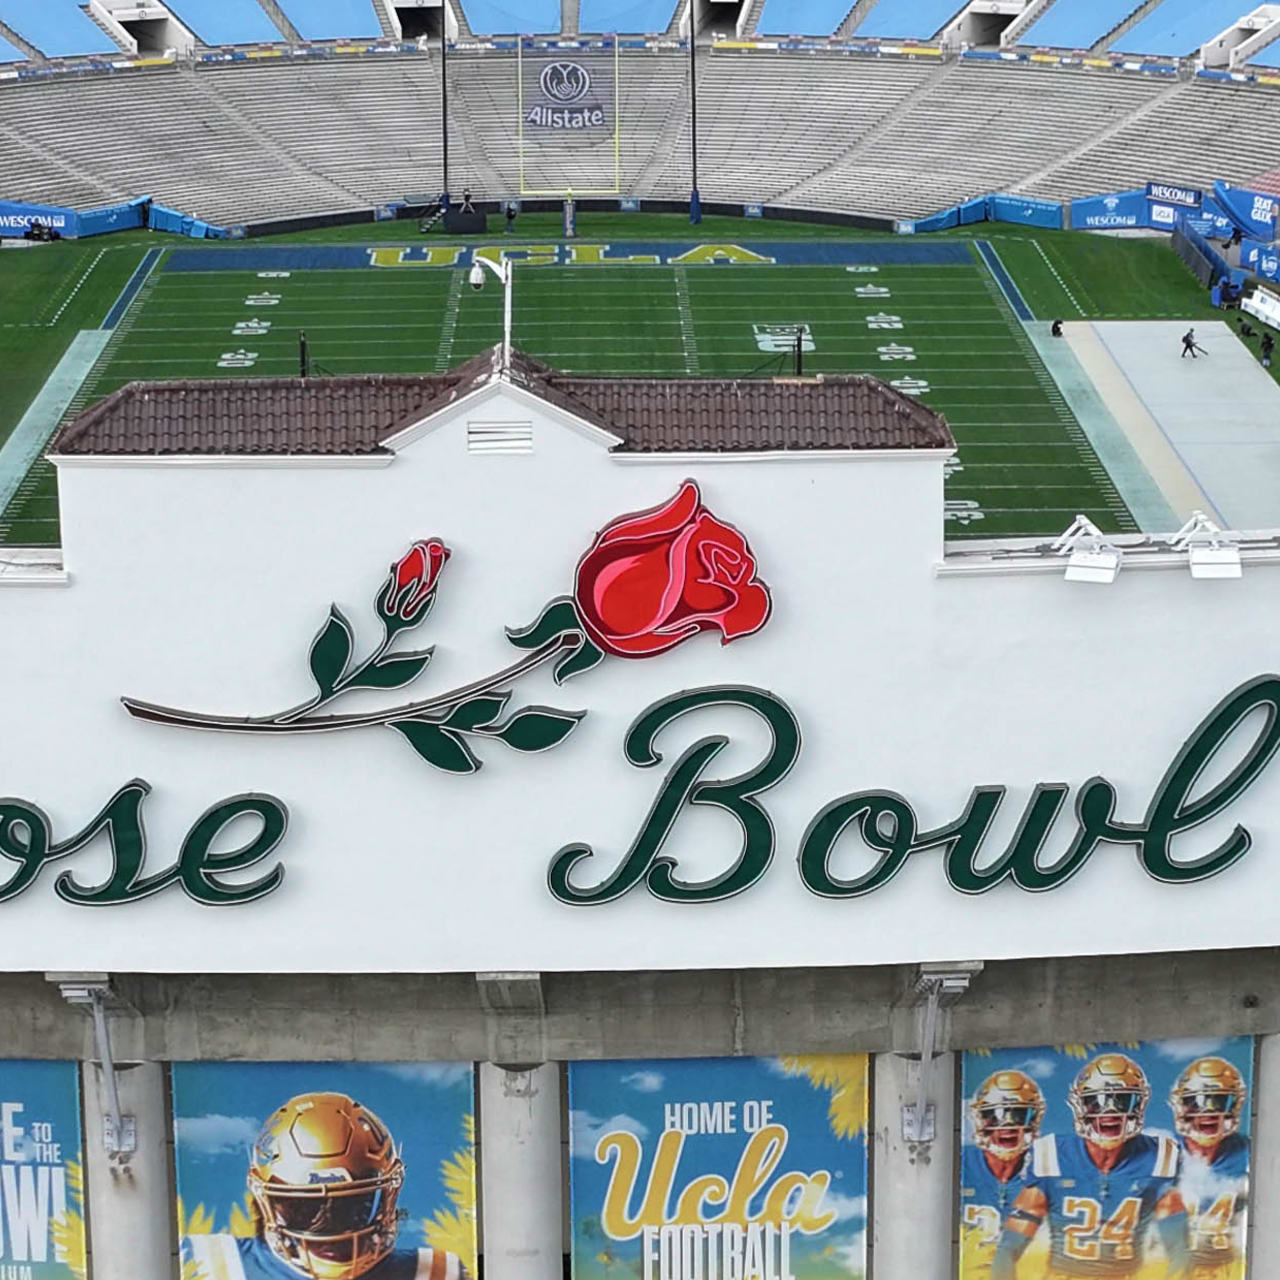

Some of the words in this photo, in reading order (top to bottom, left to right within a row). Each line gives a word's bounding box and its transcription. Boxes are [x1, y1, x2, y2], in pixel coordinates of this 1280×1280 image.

[526, 105, 604, 129] Allstate
[1151, 185, 1186, 201] WESCOM
[1253, 195, 1274, 209] SEAT
[0, 215, 53, 227] WESCOM
[1086, 216, 1127, 226] WESCOM
[1250, 208, 1273, 224] GEEK
[367, 244, 776, 266] UCLA
[664, 1101, 737, 1136] HOME
[743, 1100, 773, 1134] OF
[32, 1122, 52, 1143] TO
[33, 1142, 62, 1164] THE
[595, 1123, 839, 1241] Ucla
[1063, 1196, 1143, 1261] 24
